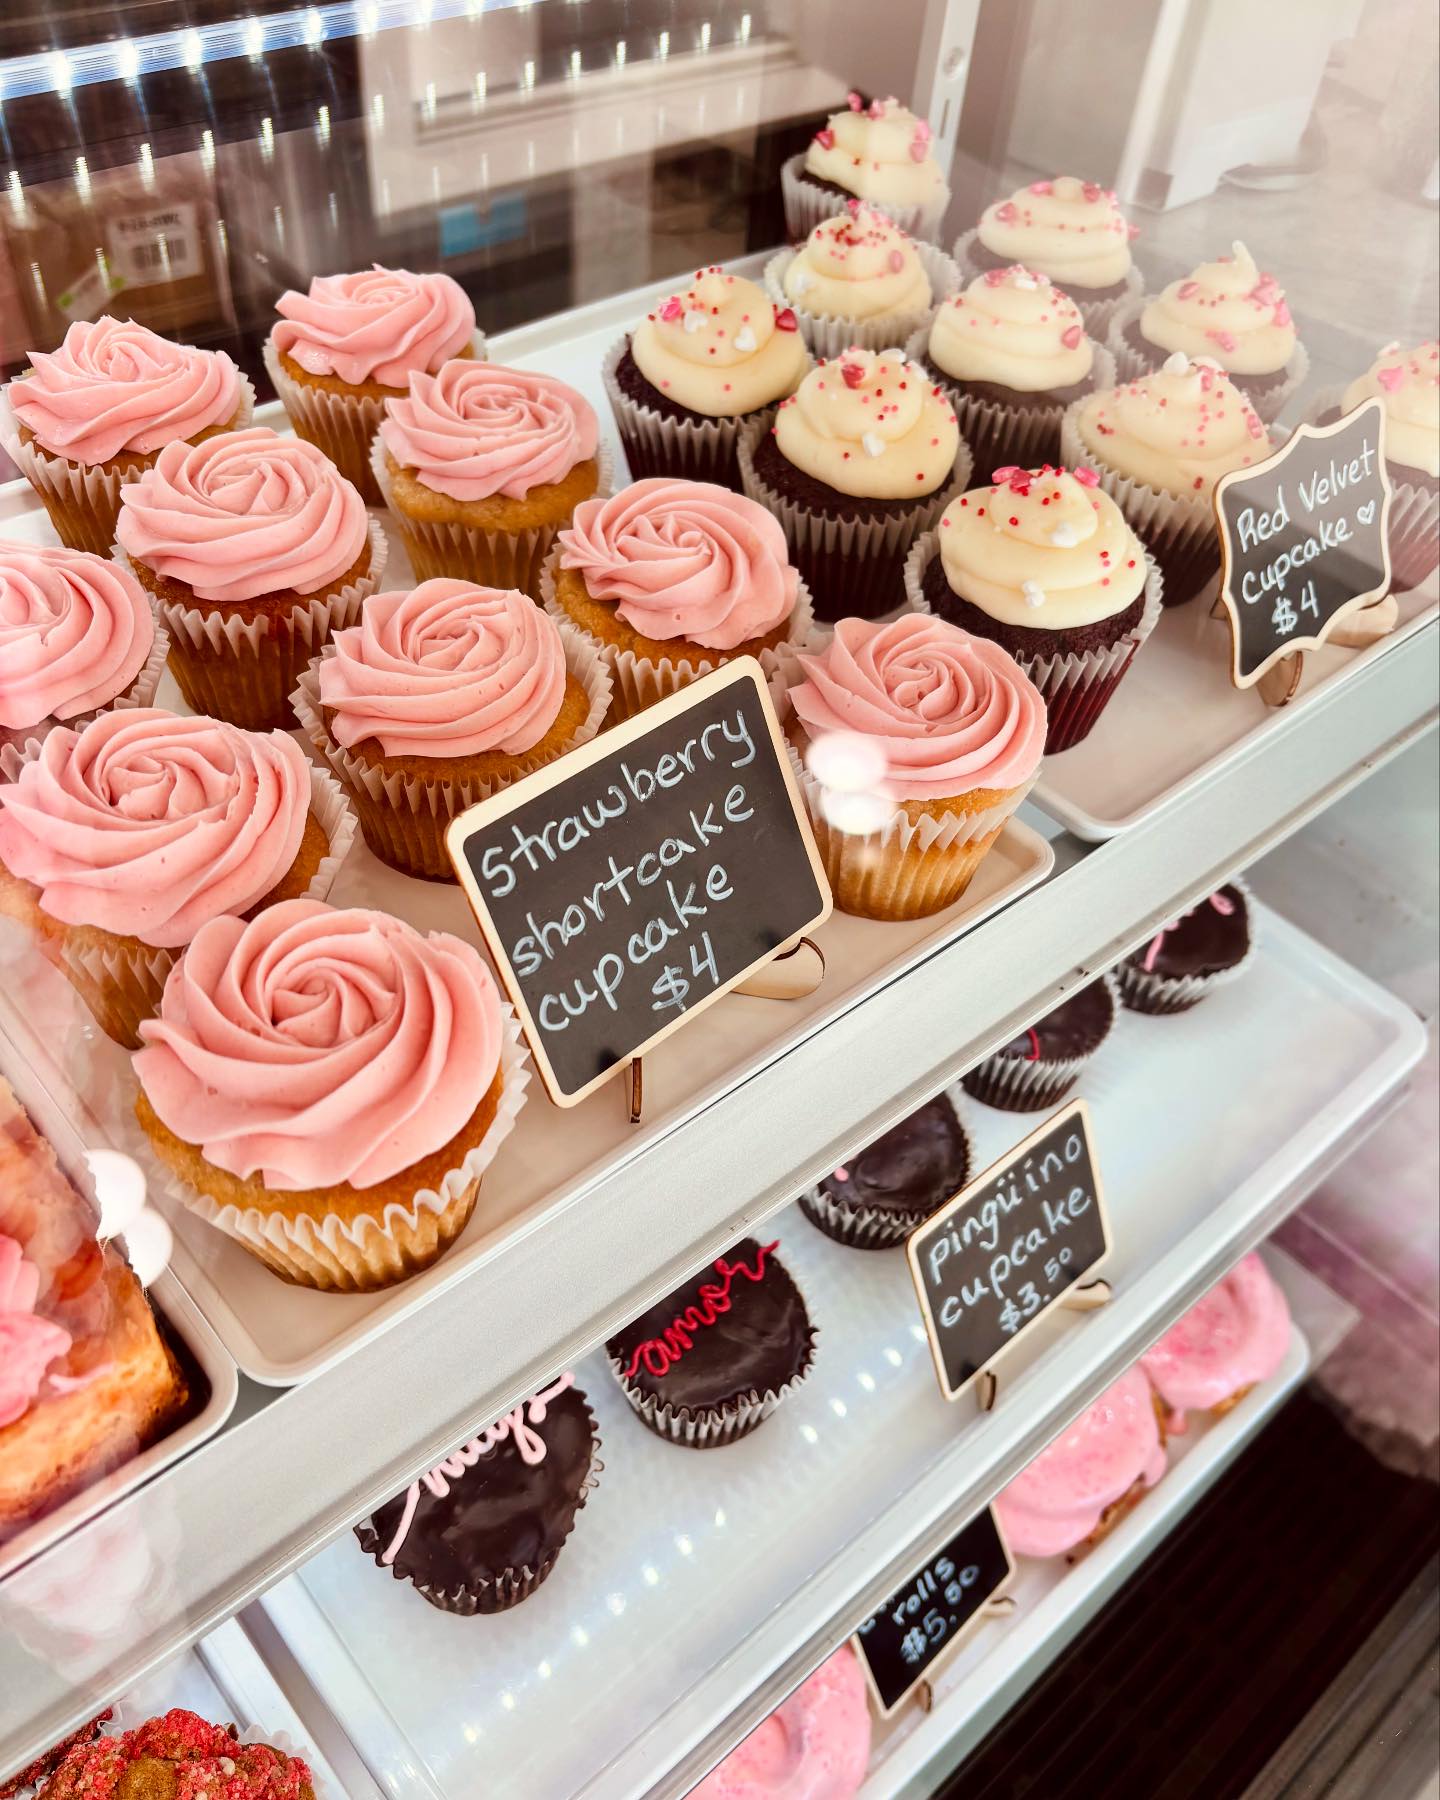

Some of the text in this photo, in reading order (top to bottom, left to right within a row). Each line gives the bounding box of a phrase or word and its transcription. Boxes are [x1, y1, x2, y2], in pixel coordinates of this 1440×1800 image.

[1236, 438, 1375, 553] Red Velvet
[1271, 580, 1319, 635] $4
[481, 709, 756, 898] Strawberry
[511, 784, 754, 977] shortcake
[538, 864, 733, 1032] cupcake
[651, 931, 719, 1012] $4
[928, 1133, 1082, 1286] pingüino
[940, 1186, 1092, 1328] cupcake
[892, 1556, 955, 1626] rolls
